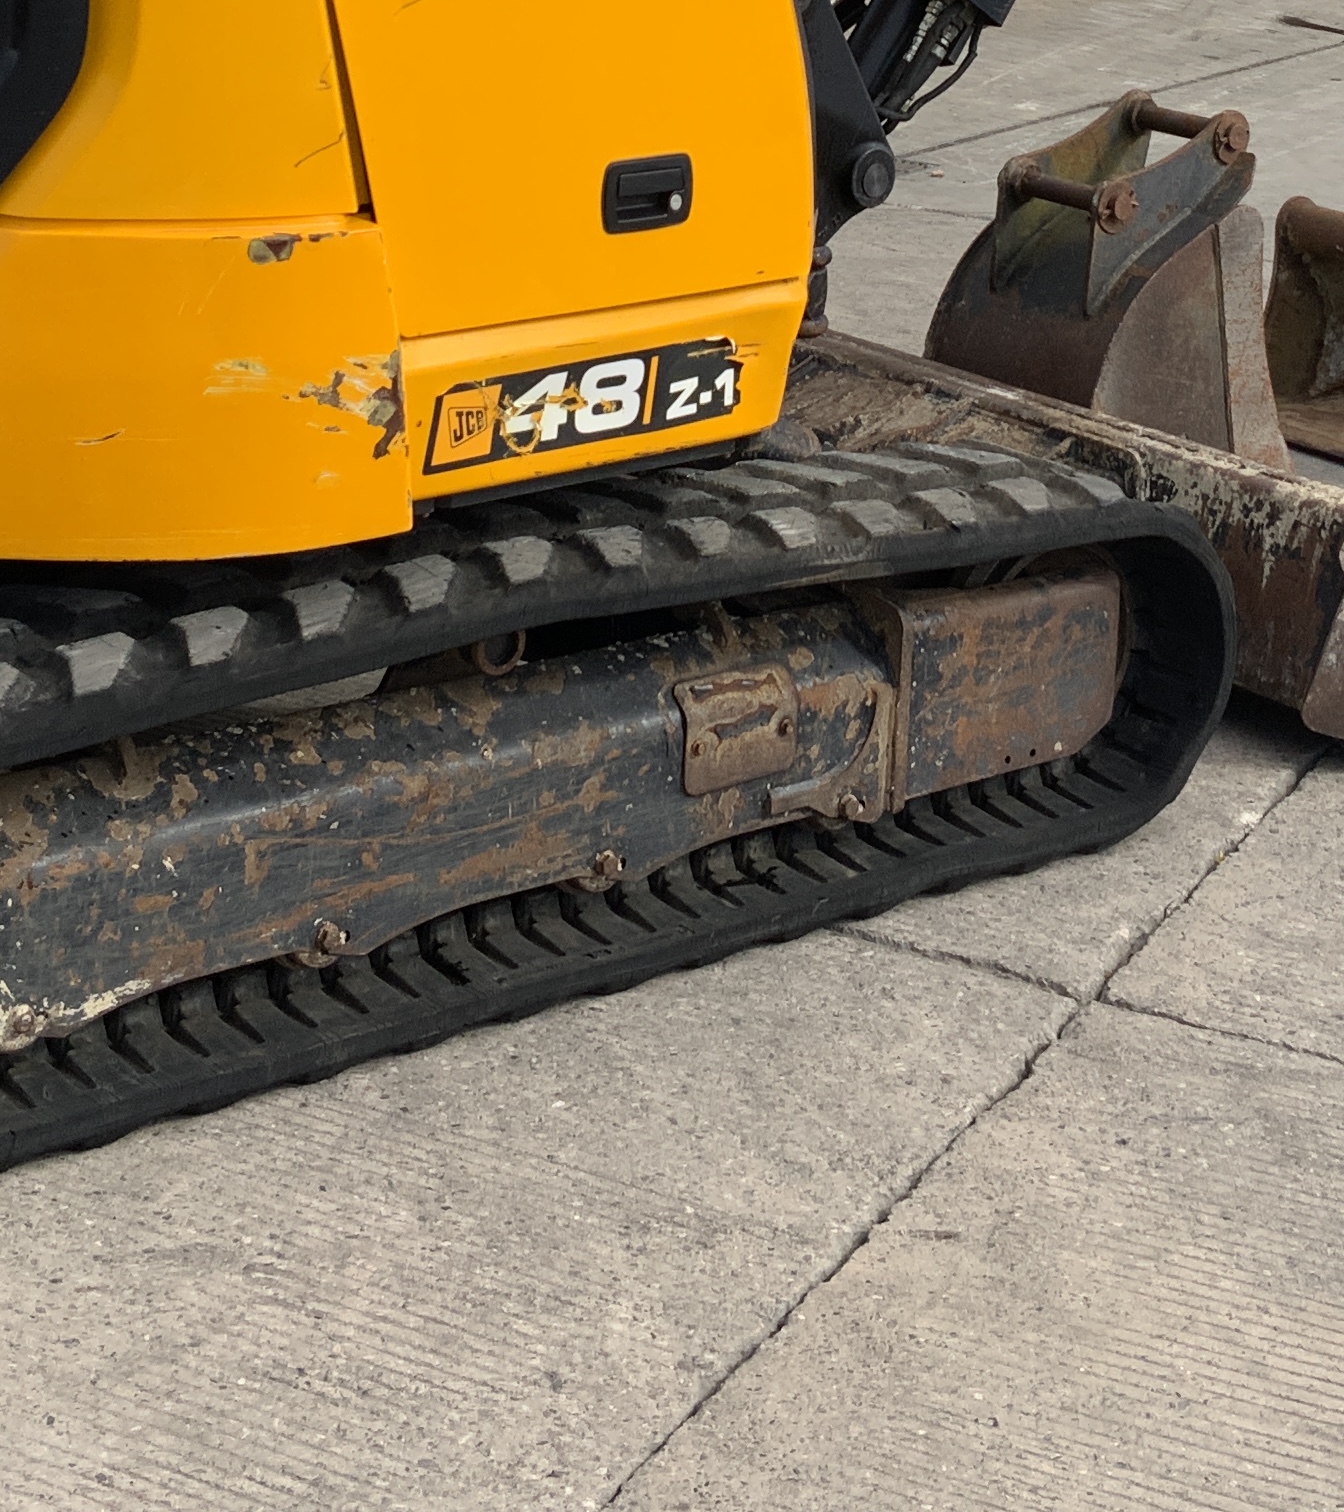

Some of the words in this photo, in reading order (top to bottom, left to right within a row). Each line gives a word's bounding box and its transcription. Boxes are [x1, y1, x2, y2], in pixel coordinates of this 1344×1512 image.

[452, 407, 487, 444] JCB
[500, 357, 646, 443] 48
[665, 367, 736, 421] Z-1
